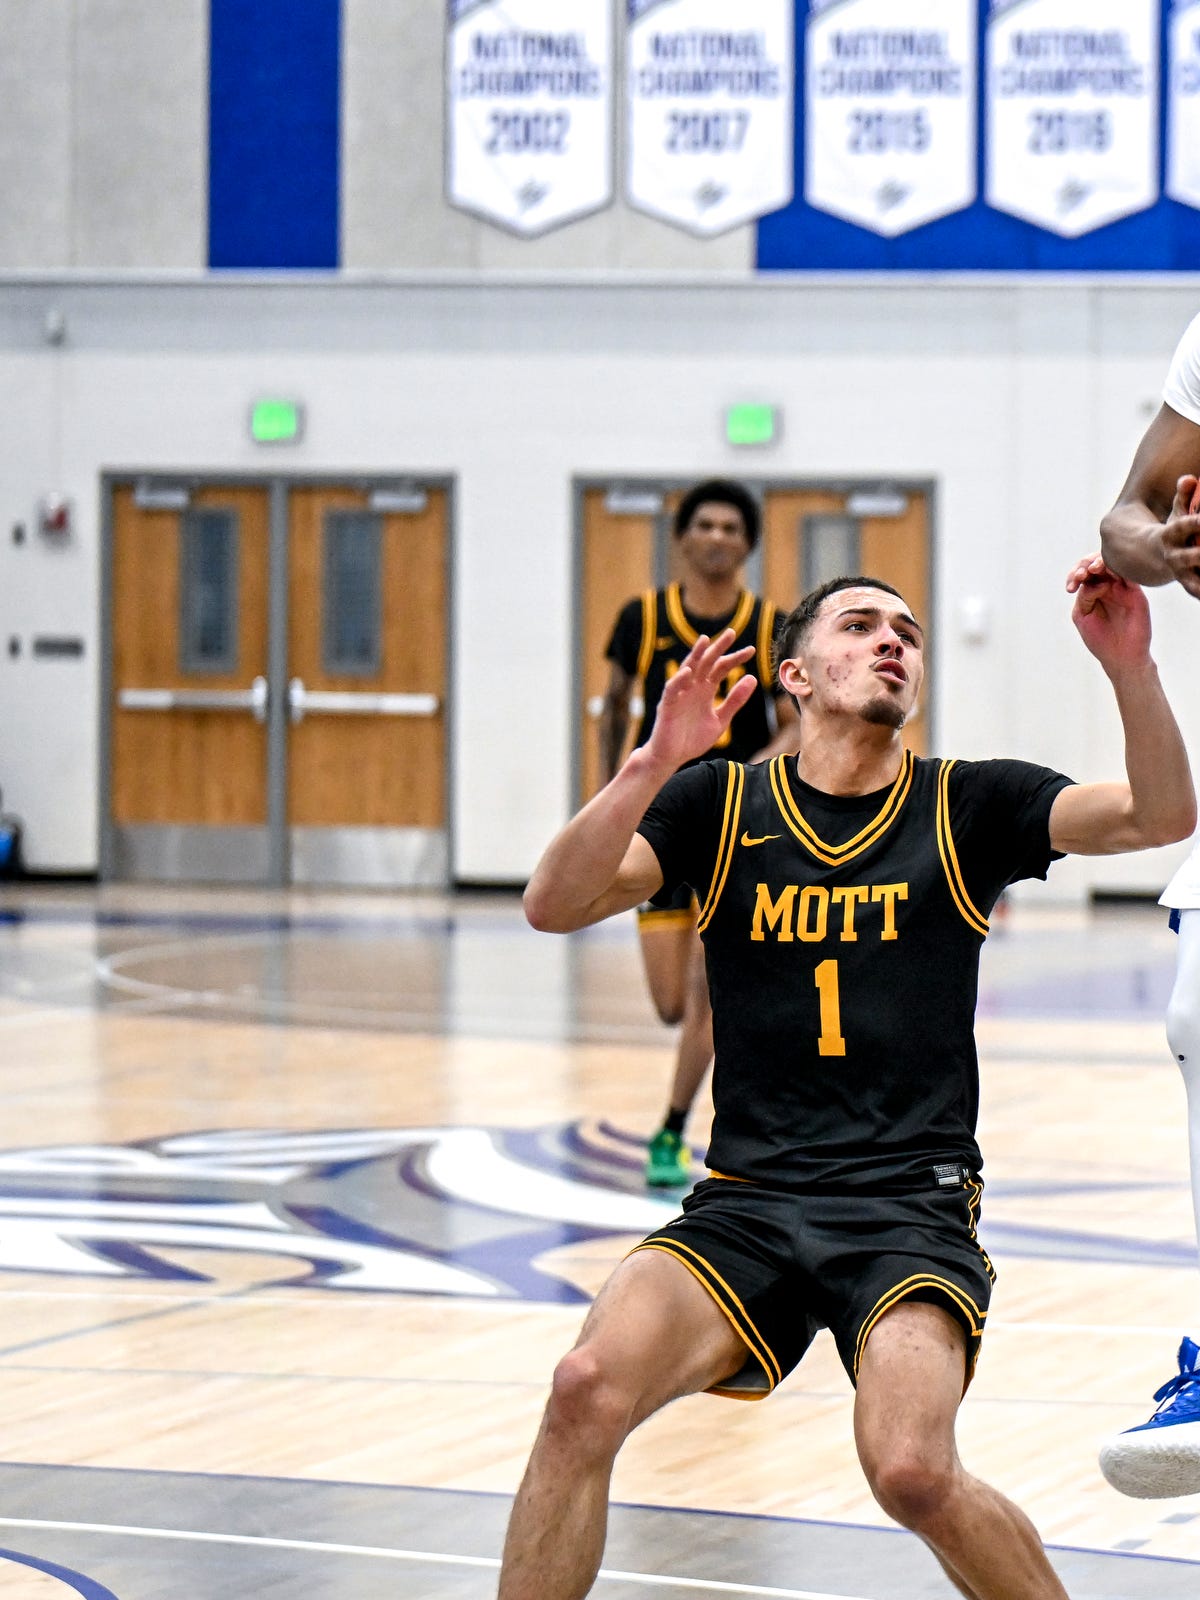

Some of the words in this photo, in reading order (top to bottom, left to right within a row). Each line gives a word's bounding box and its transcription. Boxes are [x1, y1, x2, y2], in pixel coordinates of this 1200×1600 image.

[472, 31, 585, 61] NATIONAL
[650, 31, 766, 61] NATIONAL
[831, 31, 948, 61] NATIONAL
[1011, 30, 1130, 60] NATIONAL
[460, 68, 600, 97] CHAMPIONS
[639, 67, 779, 97] CHAMPIONS
[819, 66, 966, 96] CHAMPIONS
[998, 66, 1145, 96] CHAMPIONS
[486, 109, 570, 154] 2002
[664, 108, 750, 153] 2007
[751, 883, 908, 942] MOTT
[815, 959, 846, 1056] 1
